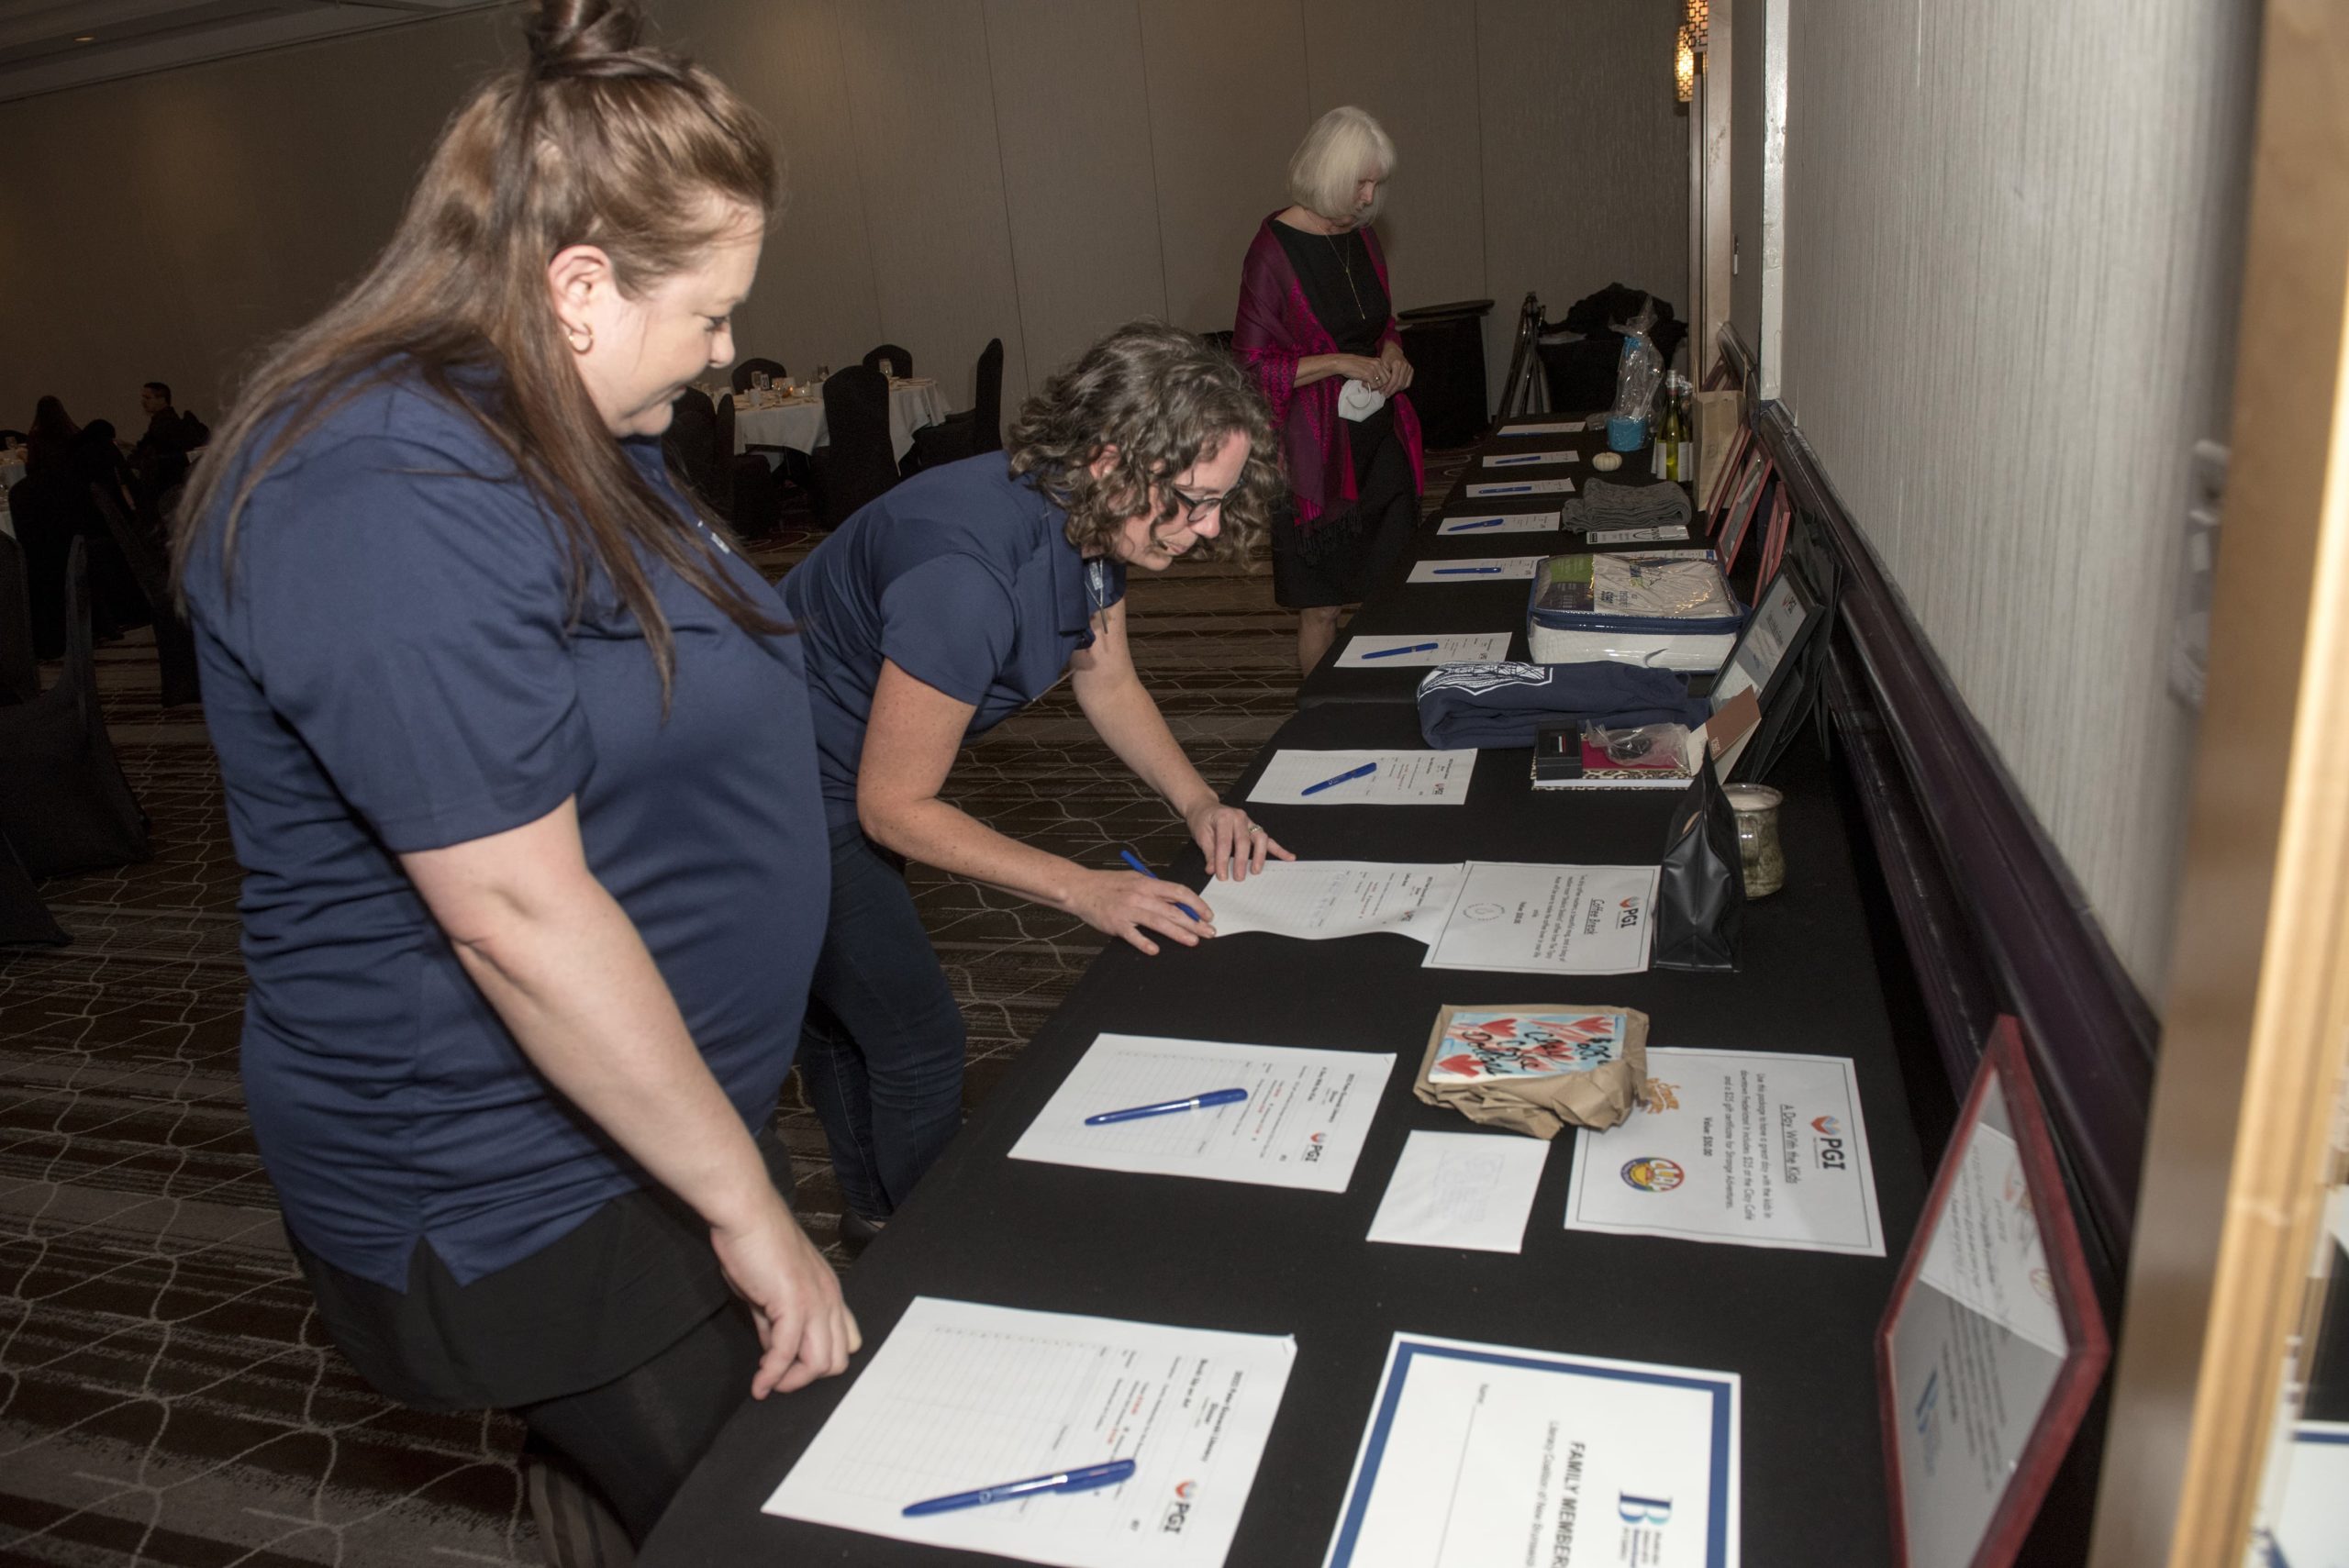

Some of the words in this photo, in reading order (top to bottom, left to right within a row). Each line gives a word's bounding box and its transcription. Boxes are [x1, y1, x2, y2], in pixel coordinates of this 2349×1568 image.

[1587, 899, 1605, 917] Coffee
[1586, 918, 1600, 935] Break
[1620, 908, 1638, 929] PGI
[1780, 1111, 1798, 1128] Day
[1785, 1130, 1799, 1149] With
[1305, 1143, 1324, 1163] PGI
[1786, 1151, 1800, 1164] the
[1820, 1137, 1846, 1171] PGI
[1786, 1165, 1802, 1184] Kids
[1563, 1441, 1586, 1495] FAMILY
[1617, 1490, 1674, 1527] B
[1163, 1502, 1191, 1535] PGI
